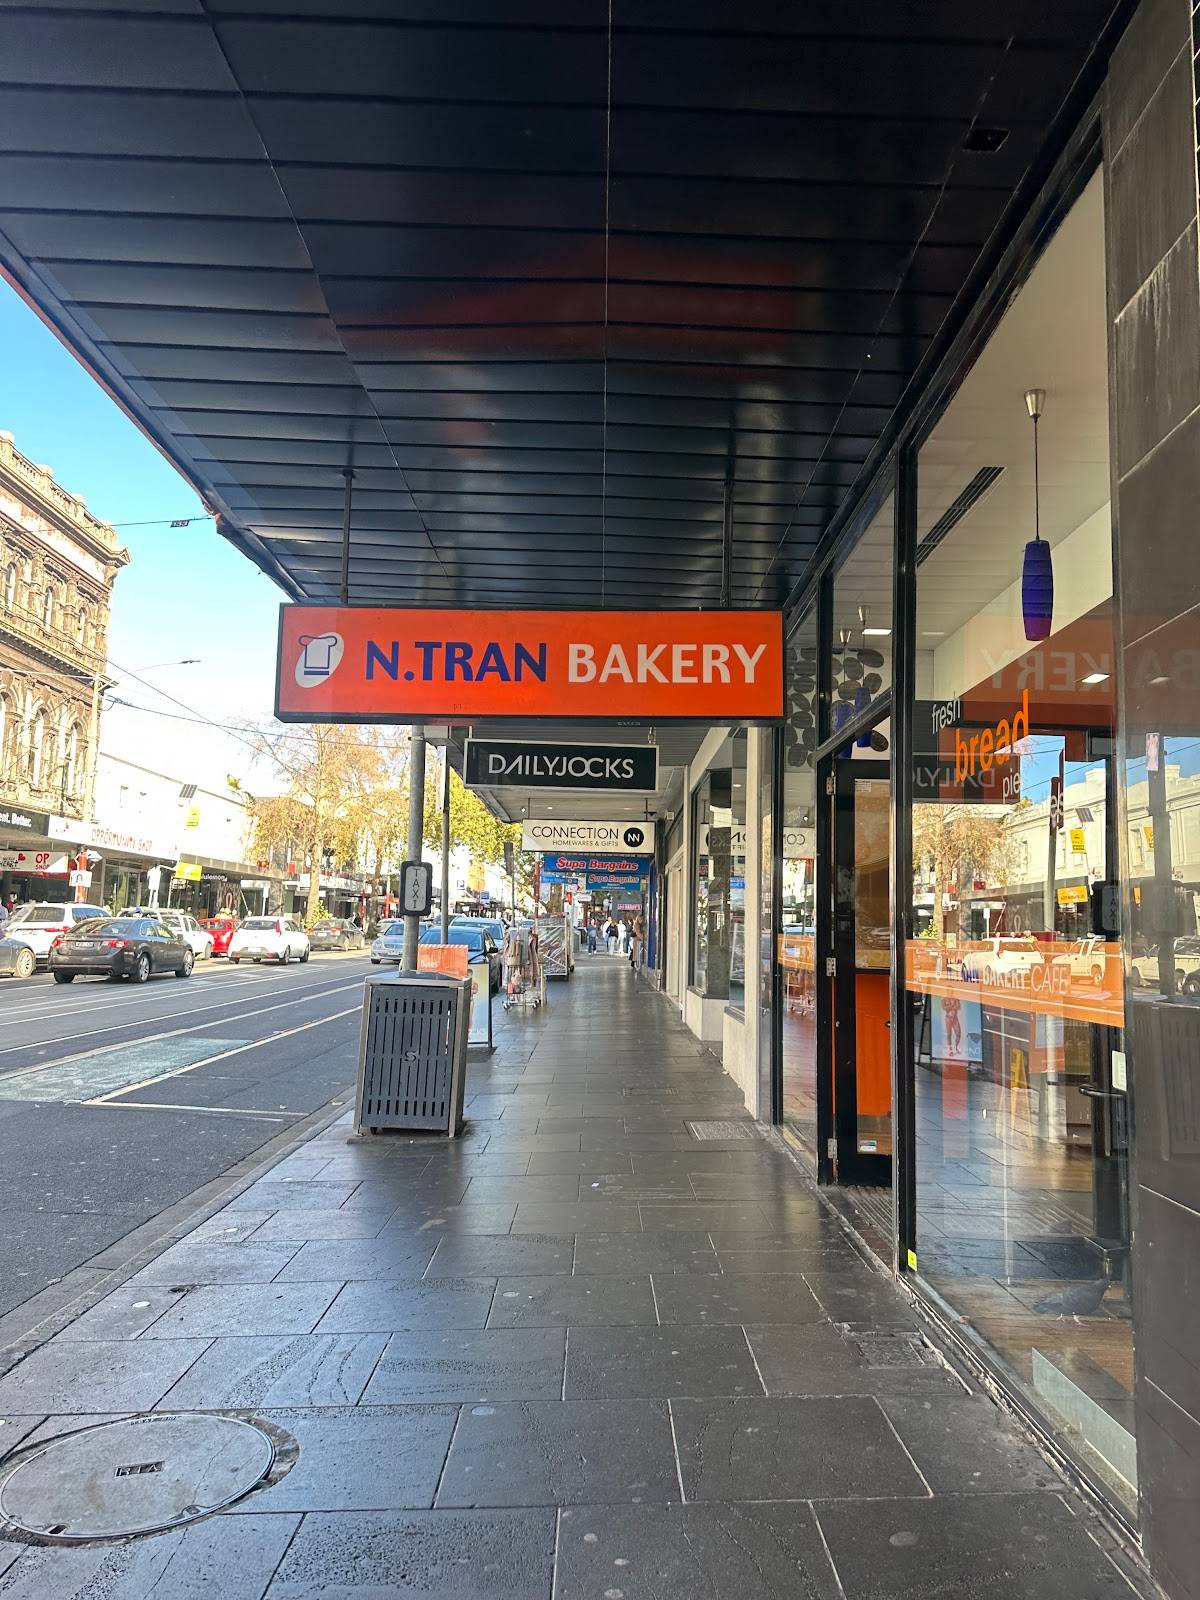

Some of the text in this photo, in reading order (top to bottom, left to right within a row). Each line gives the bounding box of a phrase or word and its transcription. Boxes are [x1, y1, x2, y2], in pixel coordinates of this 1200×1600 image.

[365, 640, 768, 685] N.TRAN BAKERY
[932, 692, 961, 735] fresh
[955, 688, 1030, 783] bread
[487, 752, 635, 779] DAILYJOCKS
[91, 828, 153, 852] OPPORTUNITY SHOP
[531, 826, 619, 840] CONNECTION
[552, 840, 592, 848] HOMEWARES
[600, 840, 619, 848] GIFTS
[35, 853, 50, 865] OP
[557, 856, 639, 872] Supa Bargains
[412, 868, 421, 909] TAXI
[1031, 965, 1069, 995] CAFE
